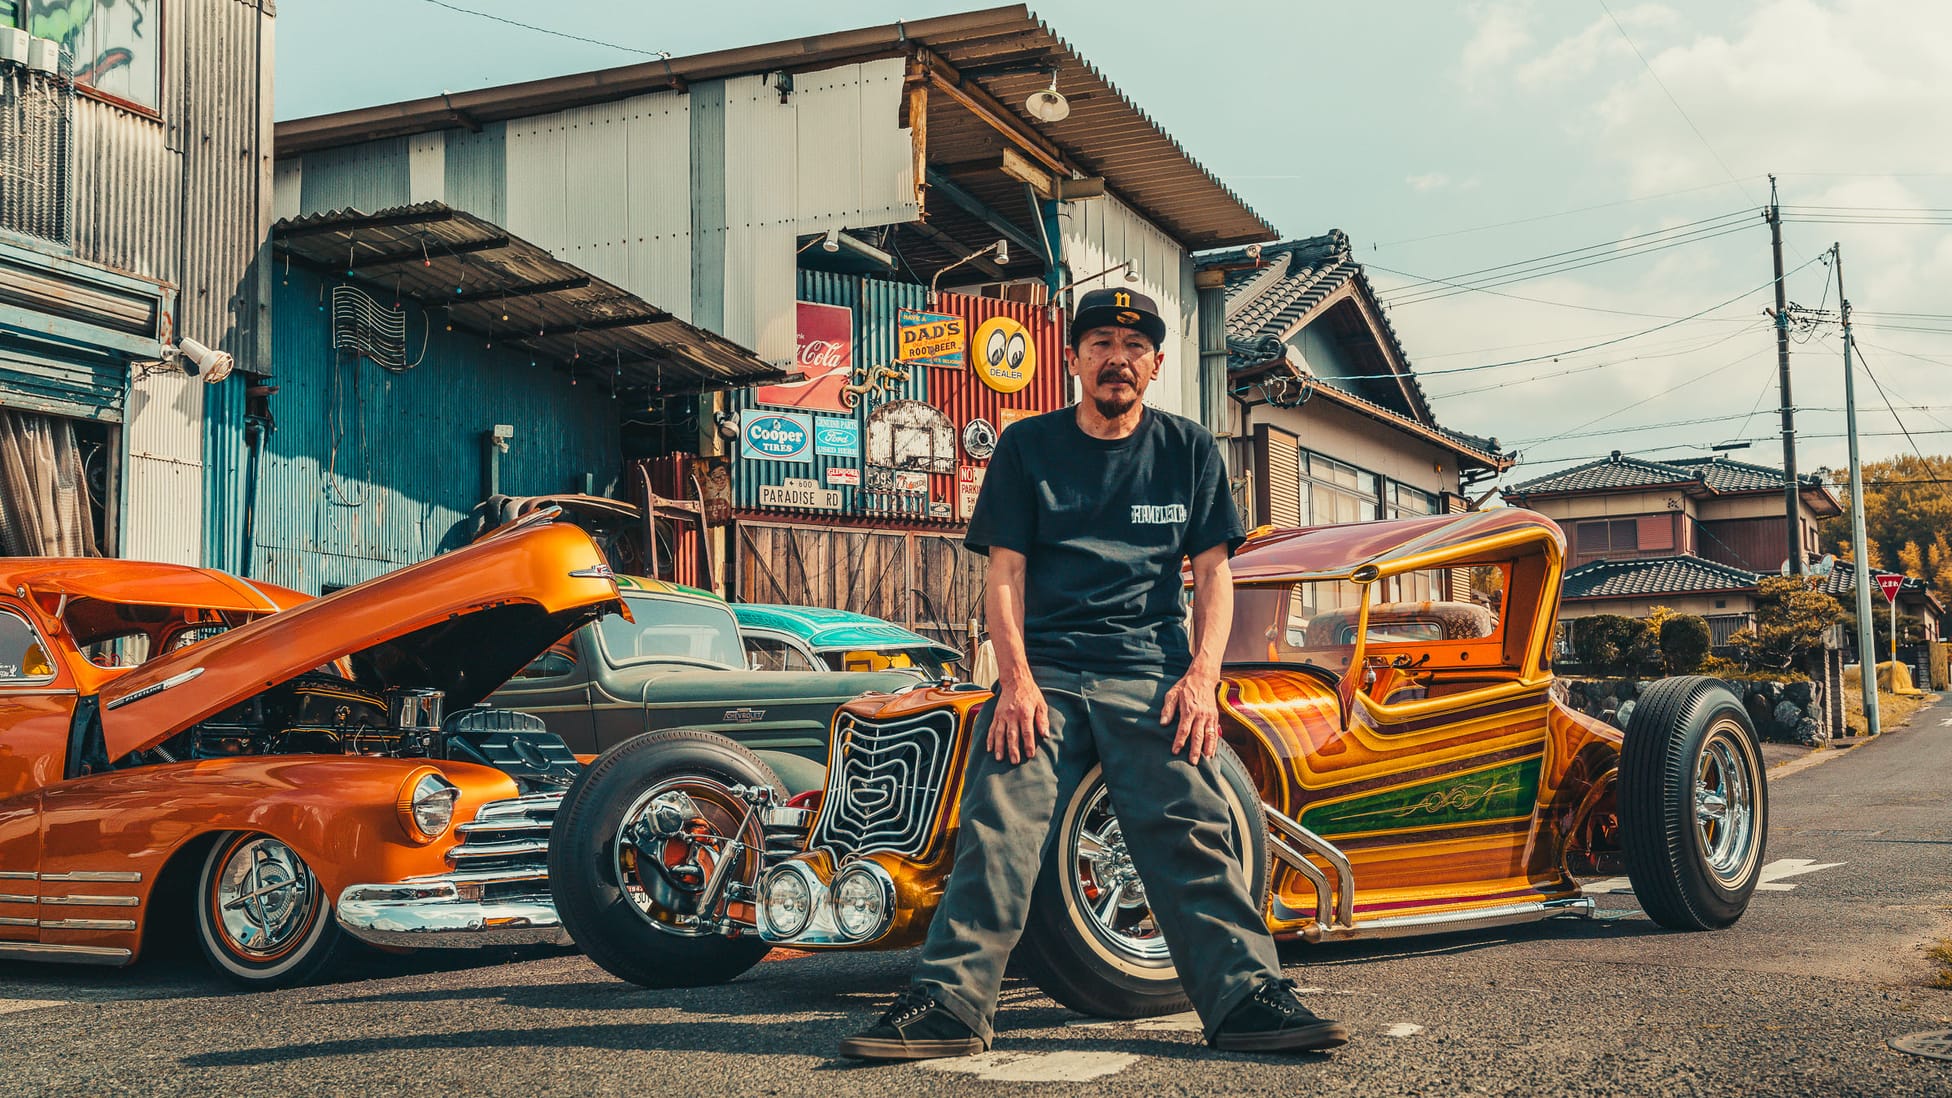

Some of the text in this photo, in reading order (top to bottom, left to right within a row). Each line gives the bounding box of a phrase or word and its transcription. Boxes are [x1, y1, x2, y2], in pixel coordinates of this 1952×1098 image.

[904, 322, 960, 344] DAD'S
[934, 341, 957, 353] BEER
[990, 368, 1023, 379] DEALER
[750, 425, 803, 444] Cooper
[825, 429, 849, 443] Ford
[762, 443, 793, 453] TIRES
[961, 468, 973, 481] NO
[961, 485, 980, 494] PARKI
[763, 489, 839, 506] PARADISE RD
[125, 686, 161, 702] FLEETLINE
